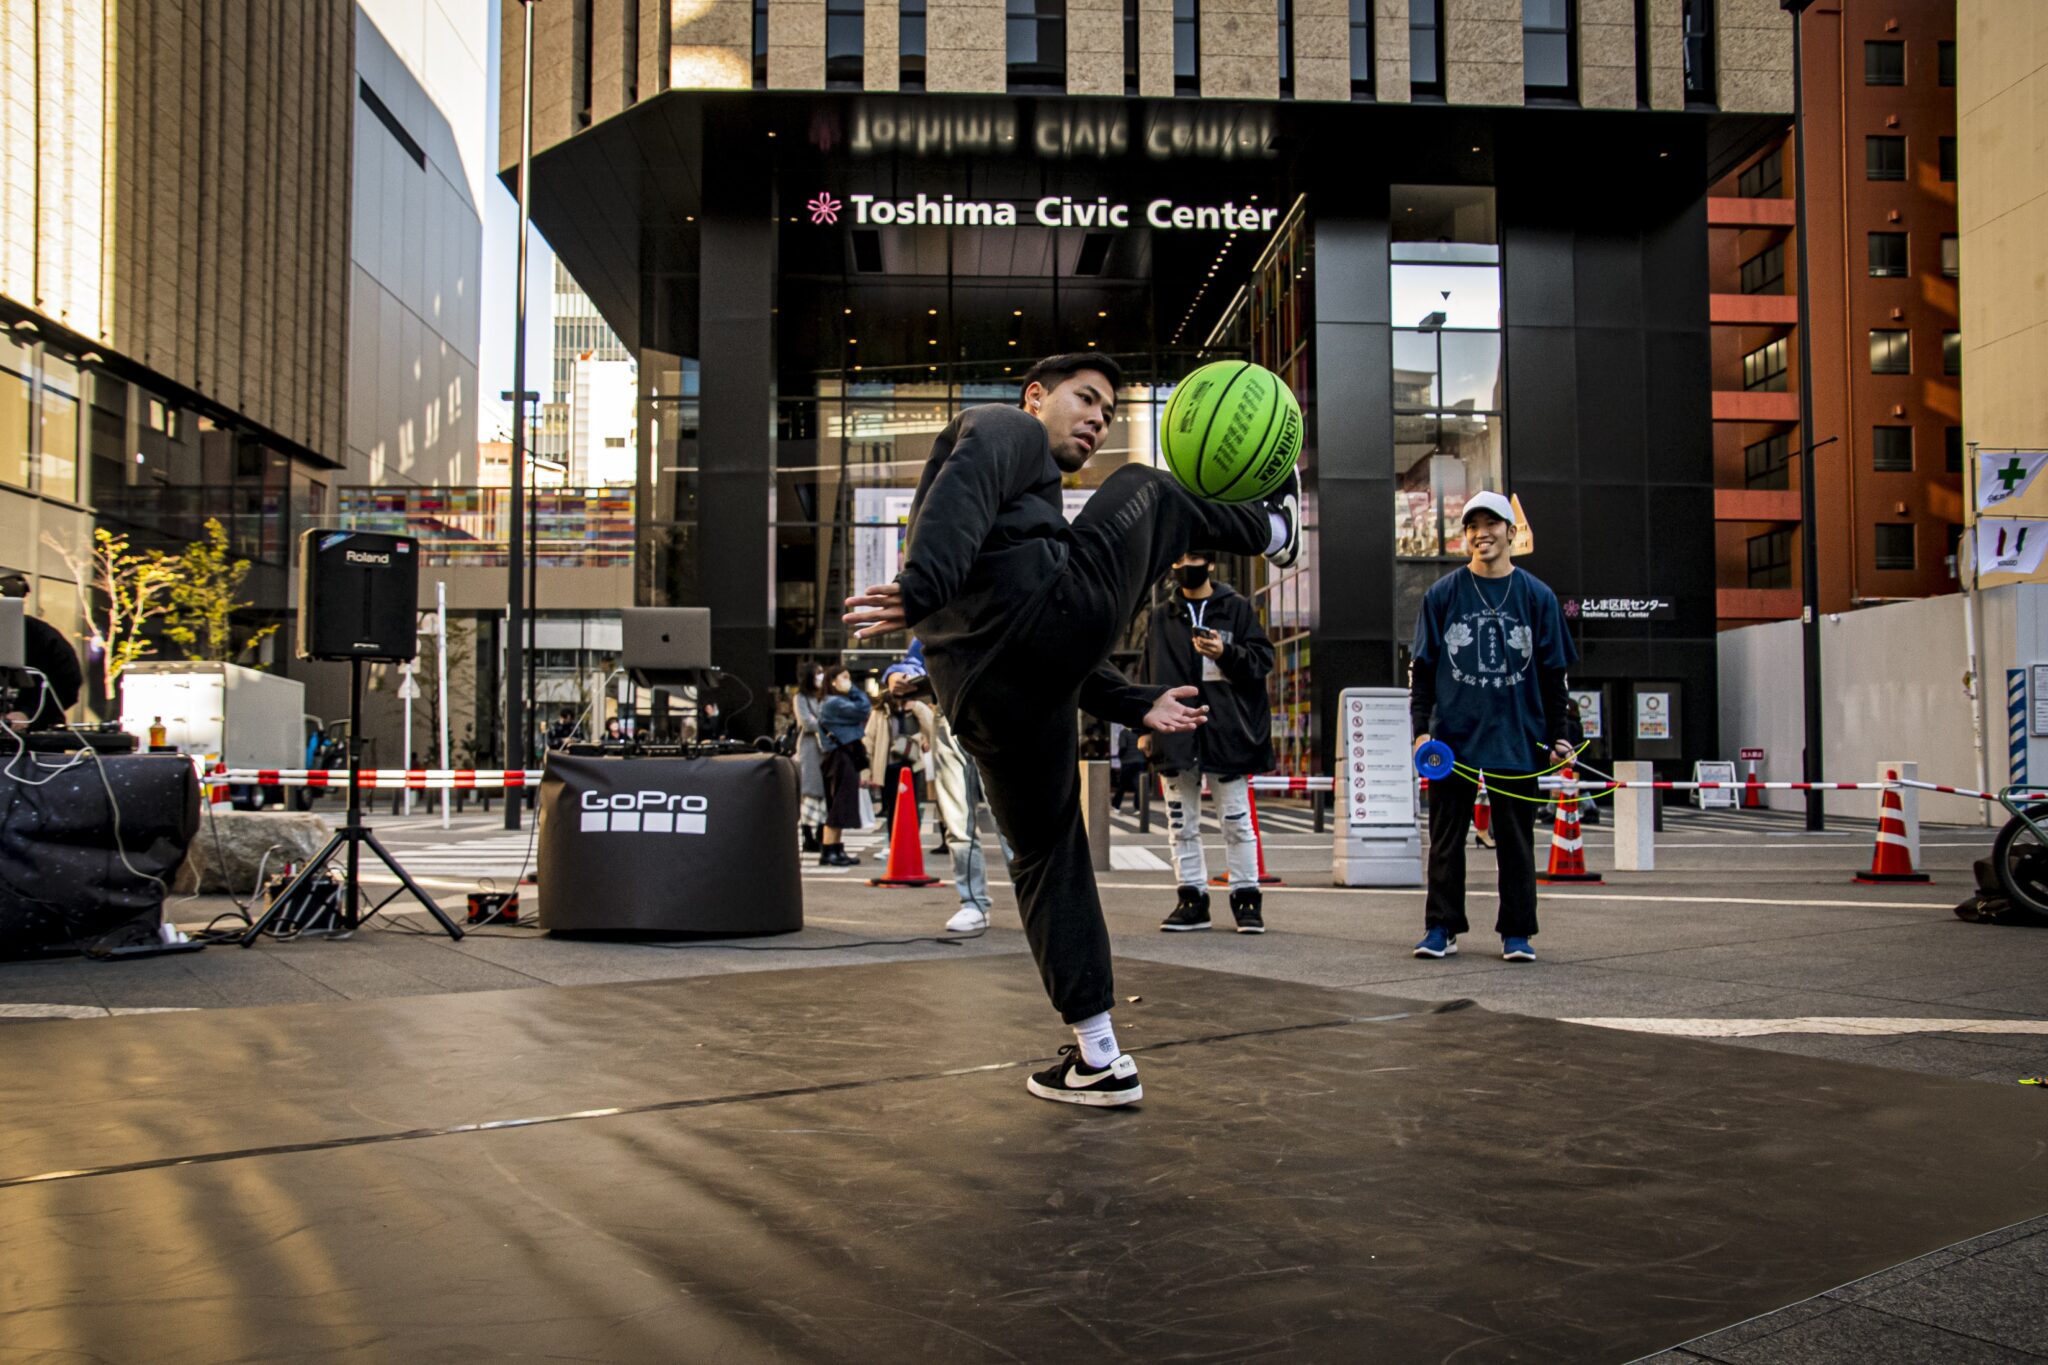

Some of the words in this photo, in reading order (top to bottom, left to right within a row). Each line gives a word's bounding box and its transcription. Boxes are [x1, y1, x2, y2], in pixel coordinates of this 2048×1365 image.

[850, 193, 1016, 226] Toshima
[1035, 196, 1129, 227] Civic
[1147, 198, 1279, 231] Center
[1259, 408, 1298, 481] TACHIKARA
[346, 550, 390, 564] Roland
[1581, 599, 1669, 611] としま区民センター
[581, 789, 708, 813] GoPro
